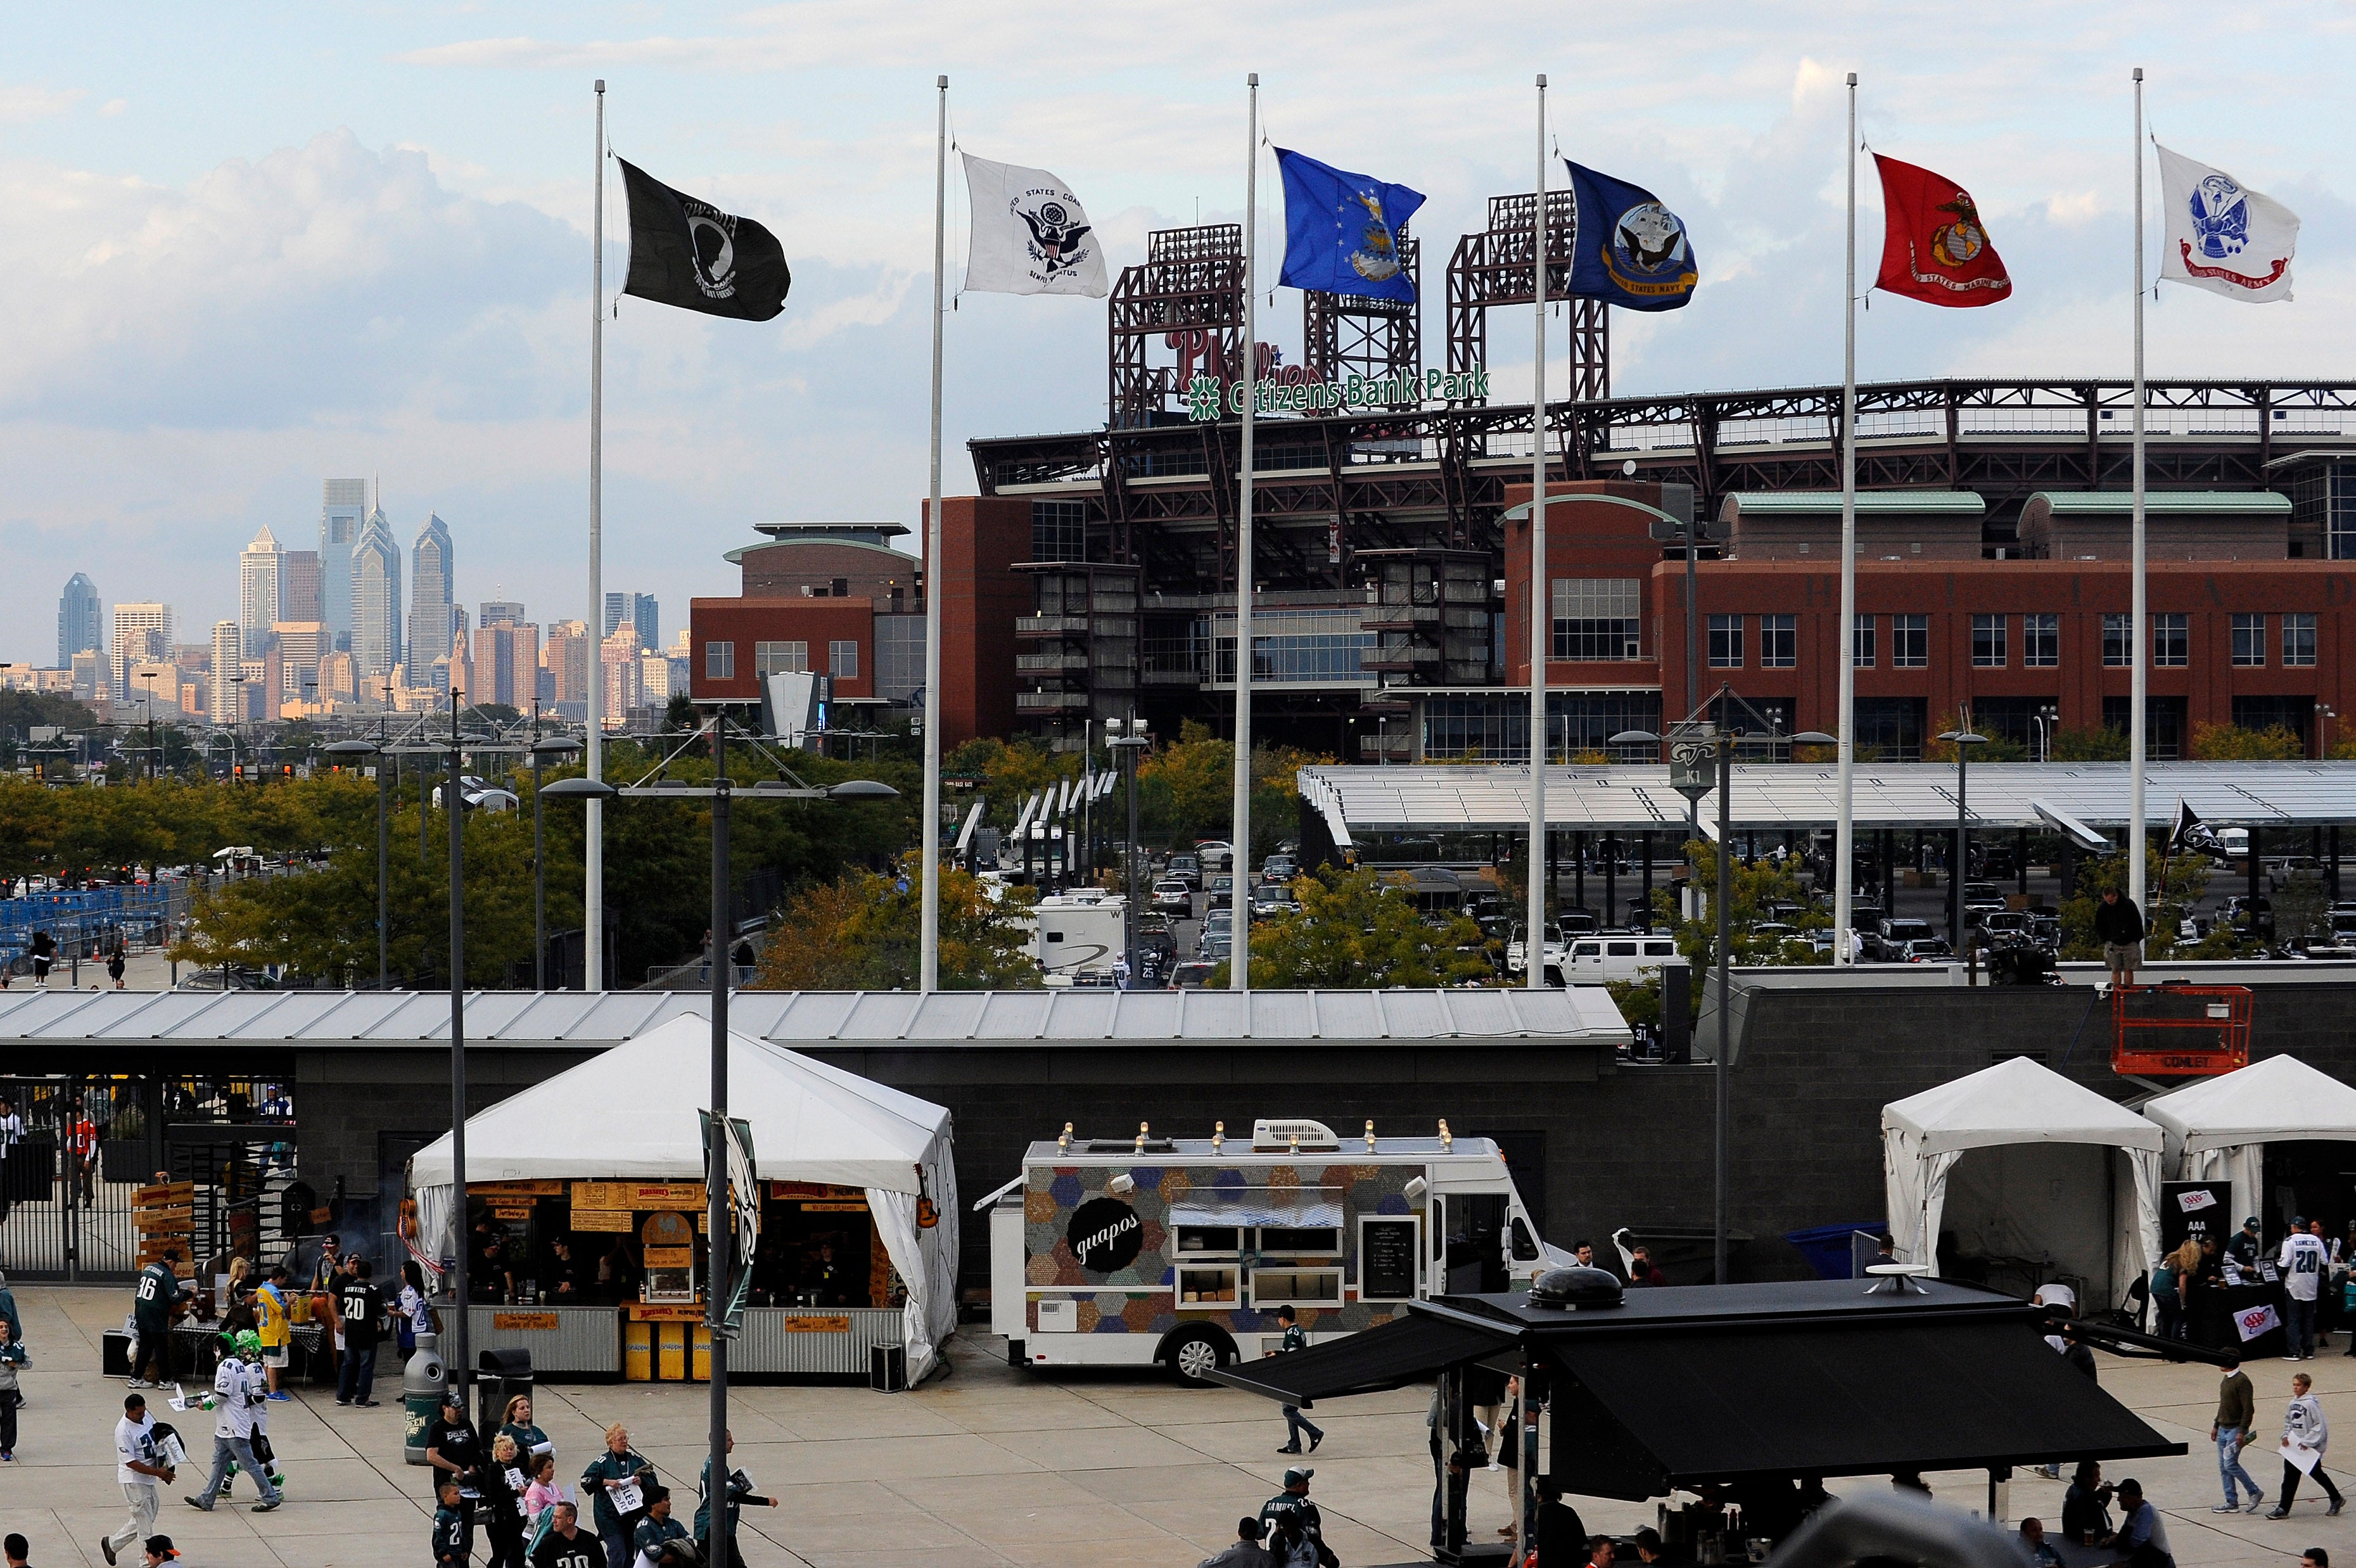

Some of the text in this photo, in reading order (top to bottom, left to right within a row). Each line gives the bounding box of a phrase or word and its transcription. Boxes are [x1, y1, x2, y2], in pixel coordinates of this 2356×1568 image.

[1026, 189, 1055, 197] STATES
[1062, 193, 1083, 210] COAS
[1631, 284, 1655, 293] STATES
[1659, 284, 1681, 293] NAVY
[1926, 274, 1957, 290] STATES
[1964, 278, 1992, 291] MARINE
[2241, 276, 2272, 289] ARMY
[1229, 361, 1491, 414] Ctizens Bank Park
[1686, 770, 1700, 784] K1
[1142, 967, 1154, 978] 25
[2185, 1195, 2202, 1204] AAA
[2187, 1221, 2206, 1231] AAA
[1076, 1213, 1140, 1265] guapos
[2295, 1250, 2318, 1273] 20
[343, 1297, 364, 1320] 20
[2245, 1313, 2265, 1327] AAA
[405, 1410, 416, 1421] GO
[1266, 1502, 1296, 1513] SAMUEL
